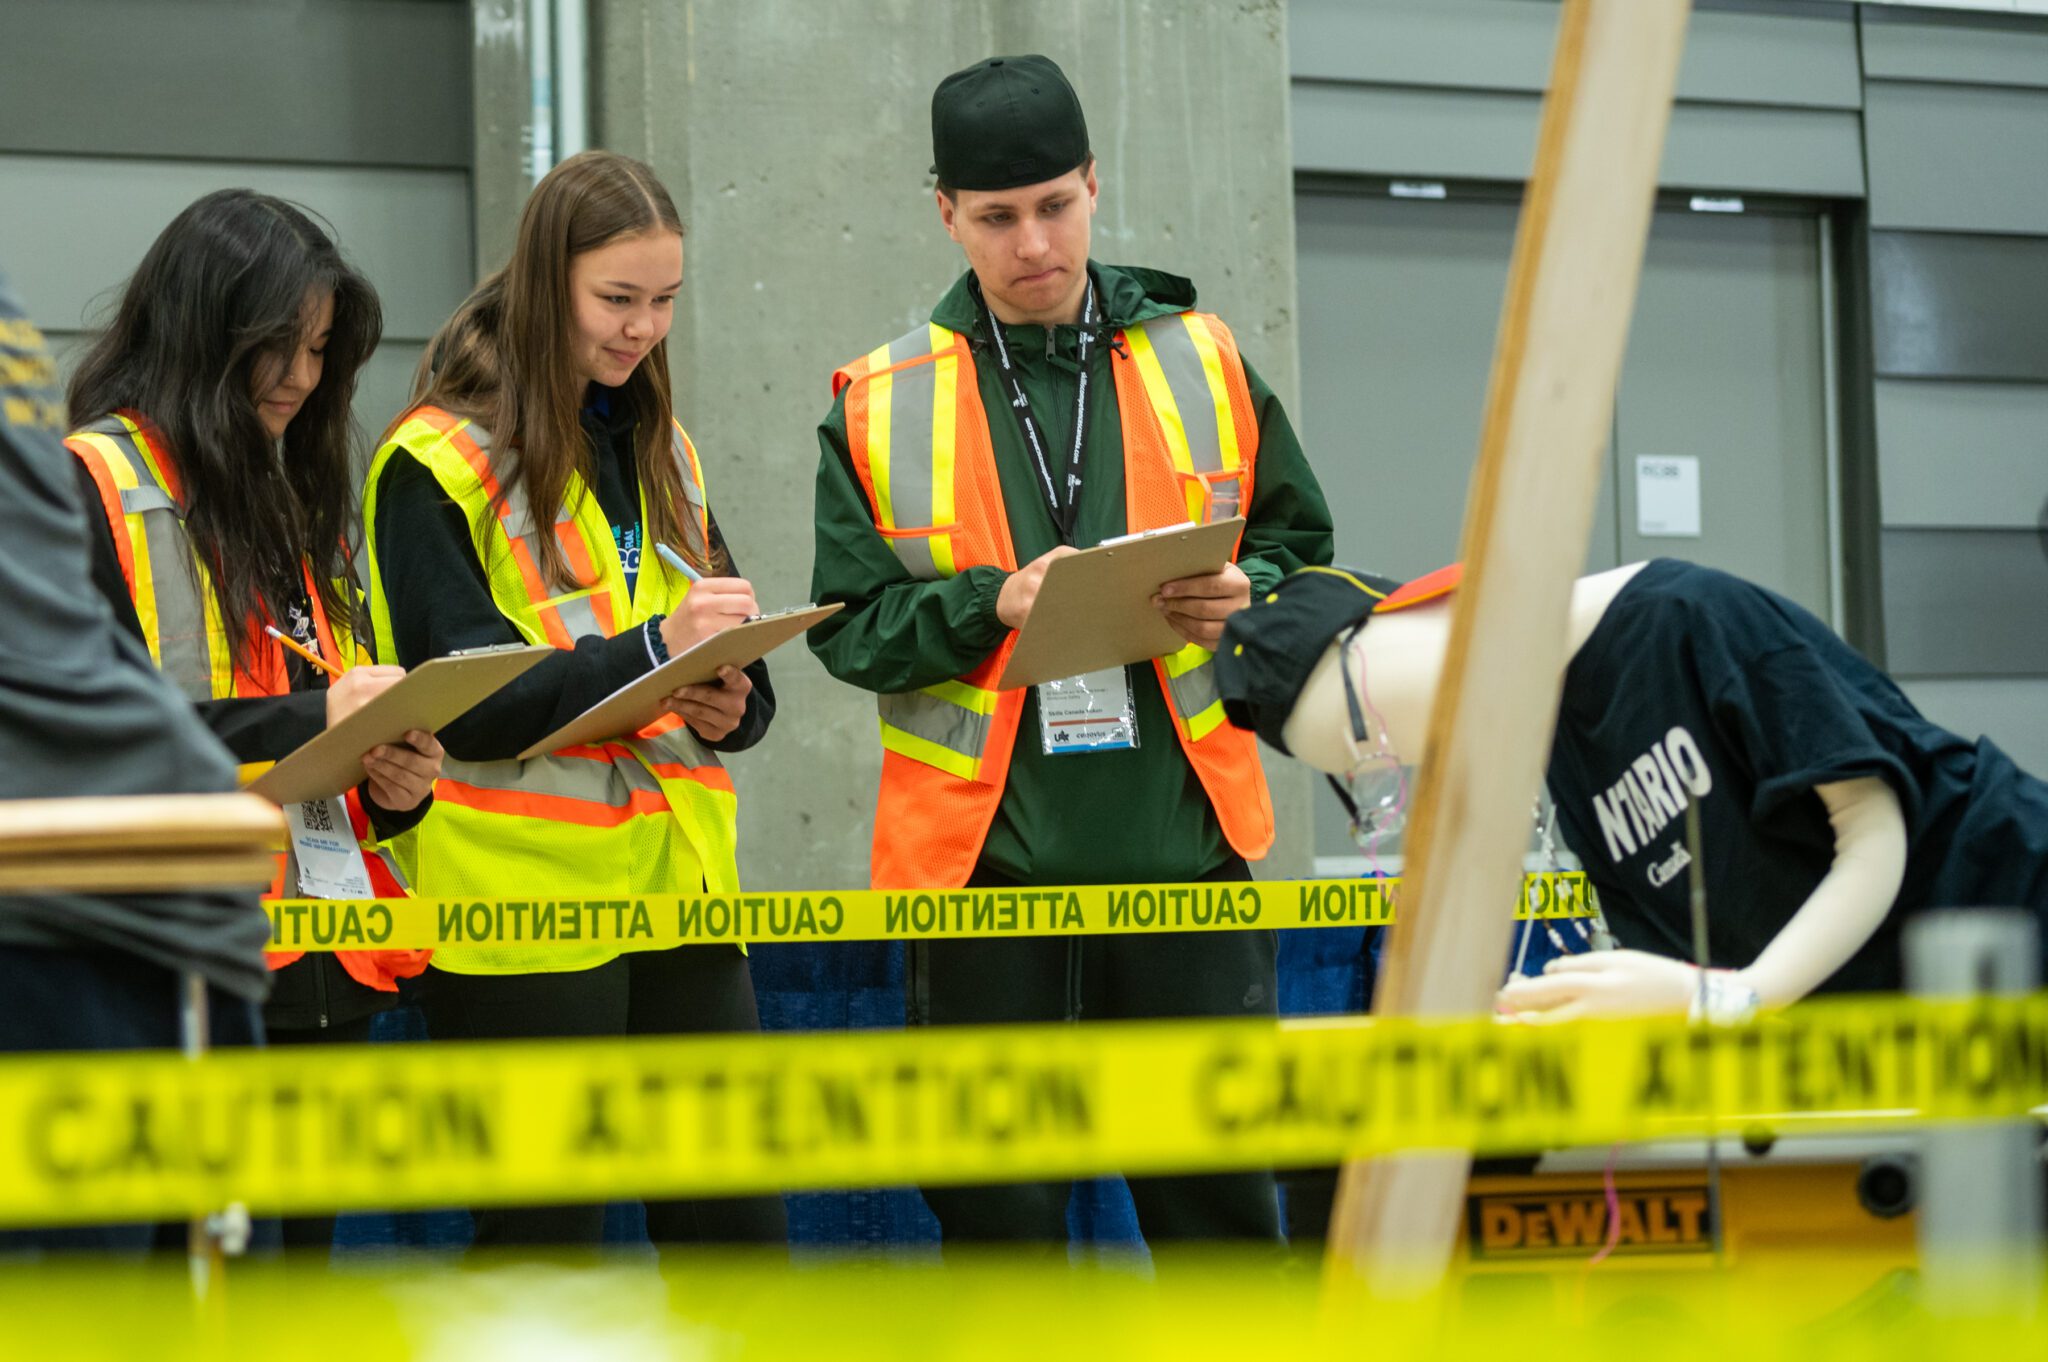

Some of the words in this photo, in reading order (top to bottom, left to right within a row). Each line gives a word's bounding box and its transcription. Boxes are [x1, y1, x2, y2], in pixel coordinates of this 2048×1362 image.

[24, 1086, 495, 1181] CAUTION
[570, 1060, 1095, 1157] ATTENTION
[1194, 1040, 1575, 1132] CAUTION
[1634, 1020, 2047, 1108] ATTENTION
